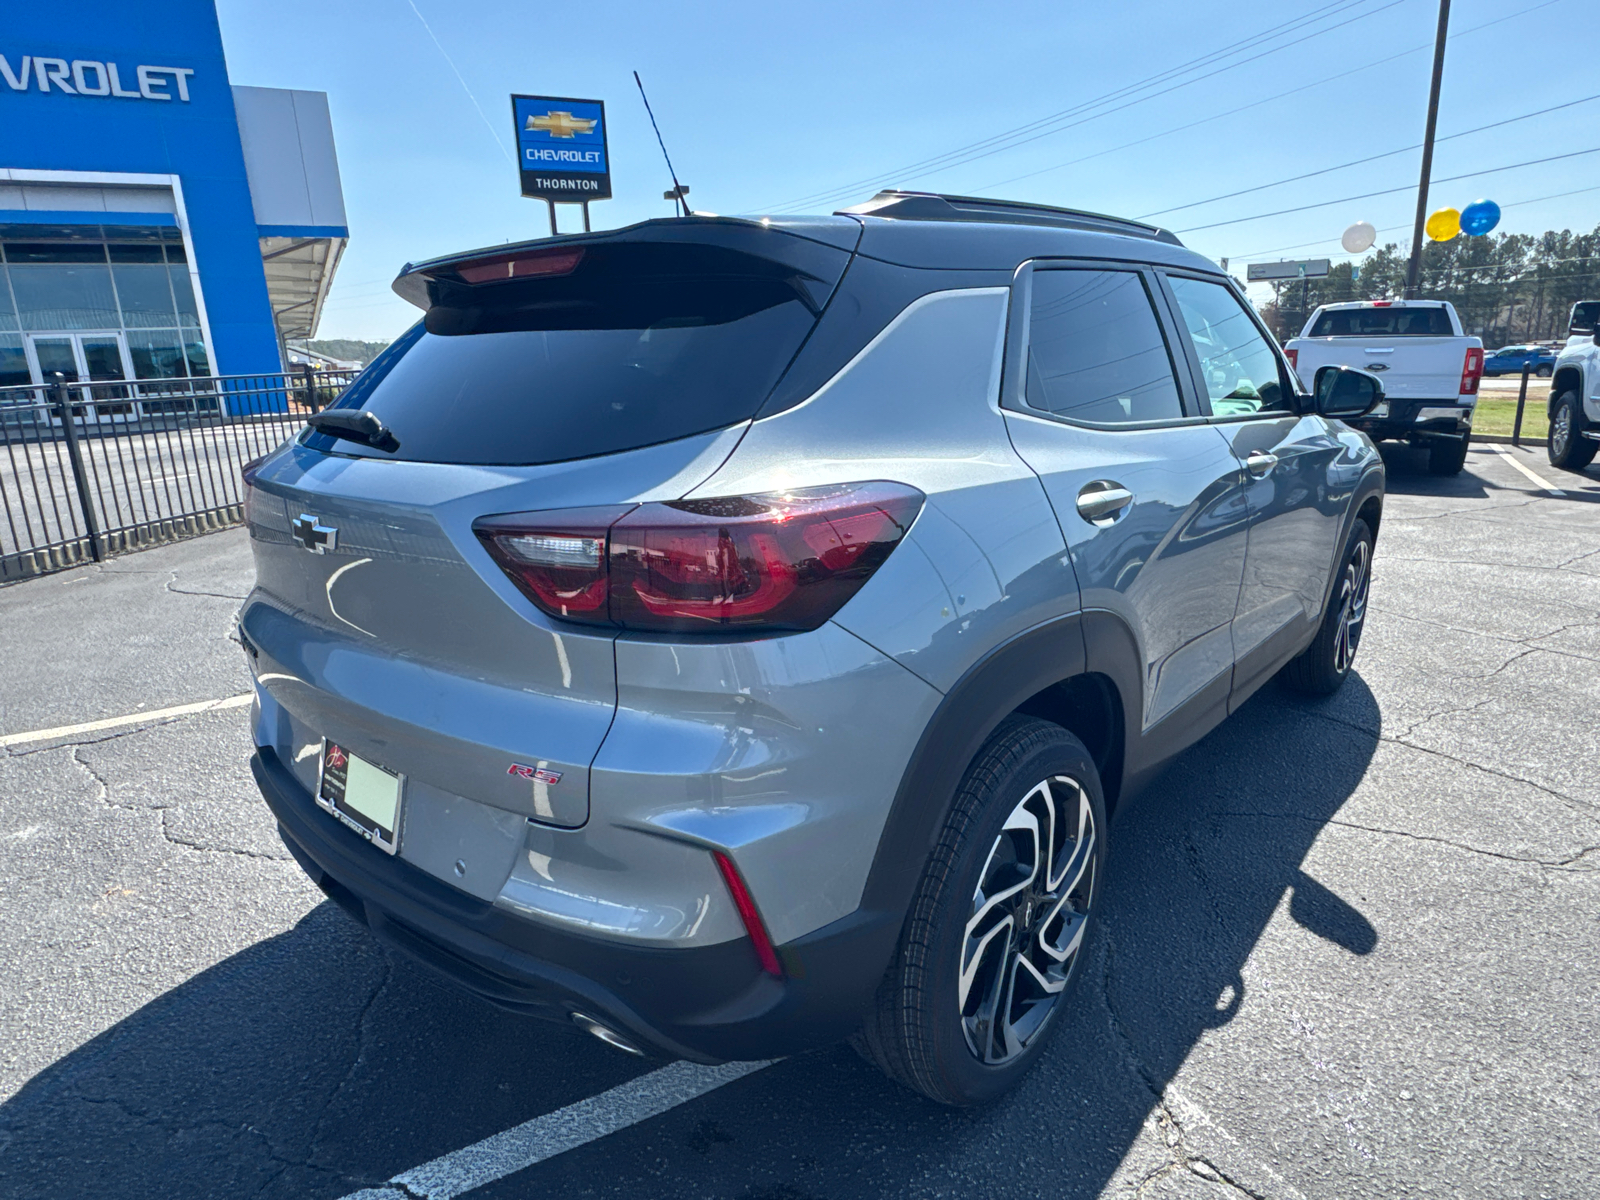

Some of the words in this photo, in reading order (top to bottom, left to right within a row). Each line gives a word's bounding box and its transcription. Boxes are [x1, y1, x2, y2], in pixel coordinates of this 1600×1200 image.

[526, 148, 600, 163] CHEVROLET
[536, 178, 598, 190] THORNTON
[507, 763, 562, 785] RS
